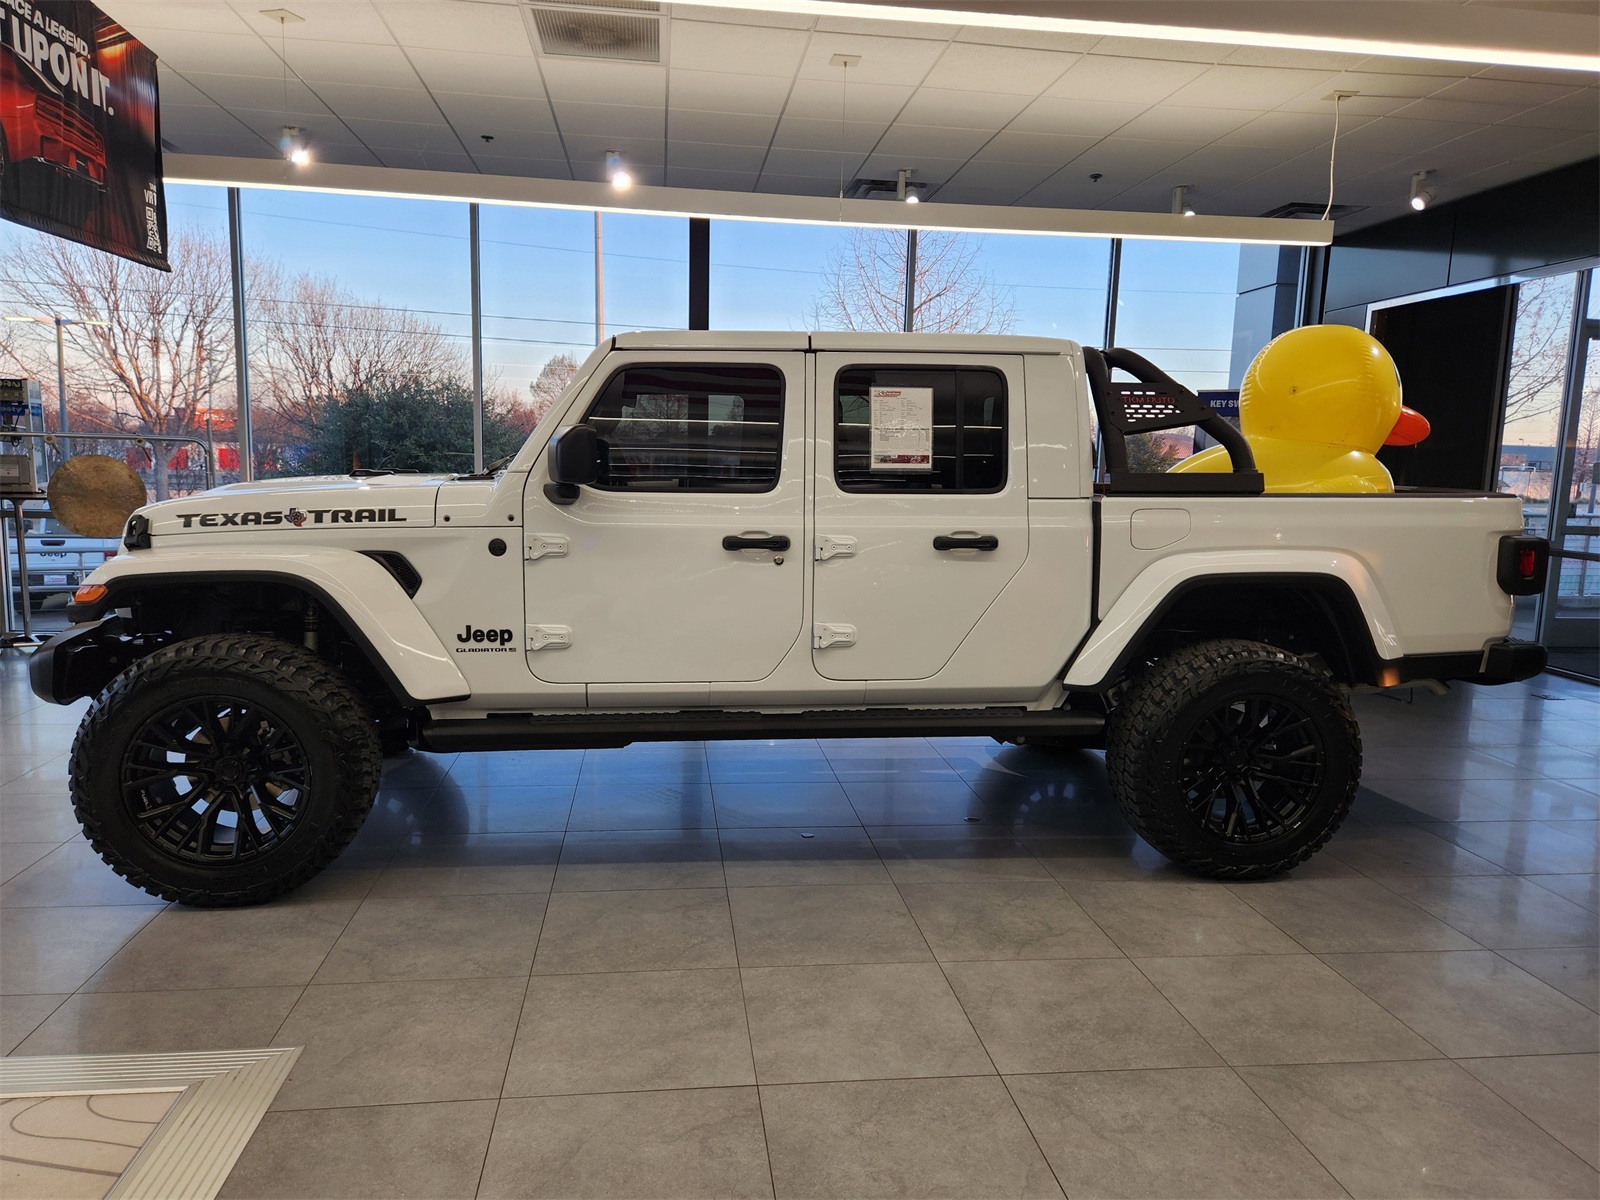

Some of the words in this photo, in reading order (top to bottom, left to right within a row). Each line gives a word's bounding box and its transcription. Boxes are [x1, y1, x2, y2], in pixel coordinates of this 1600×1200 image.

[33, 10, 44, 29] A
[45, 16, 91, 60] LEGEND.
[11, 14, 89, 99] UPON
[91, 66, 114, 116] IT.
[1210, 400, 1227, 408] KEY
[176, 510, 284, 528] TEXAS
[307, 508, 407, 524] TRAIL
[457, 624, 513, 646] Jeep
